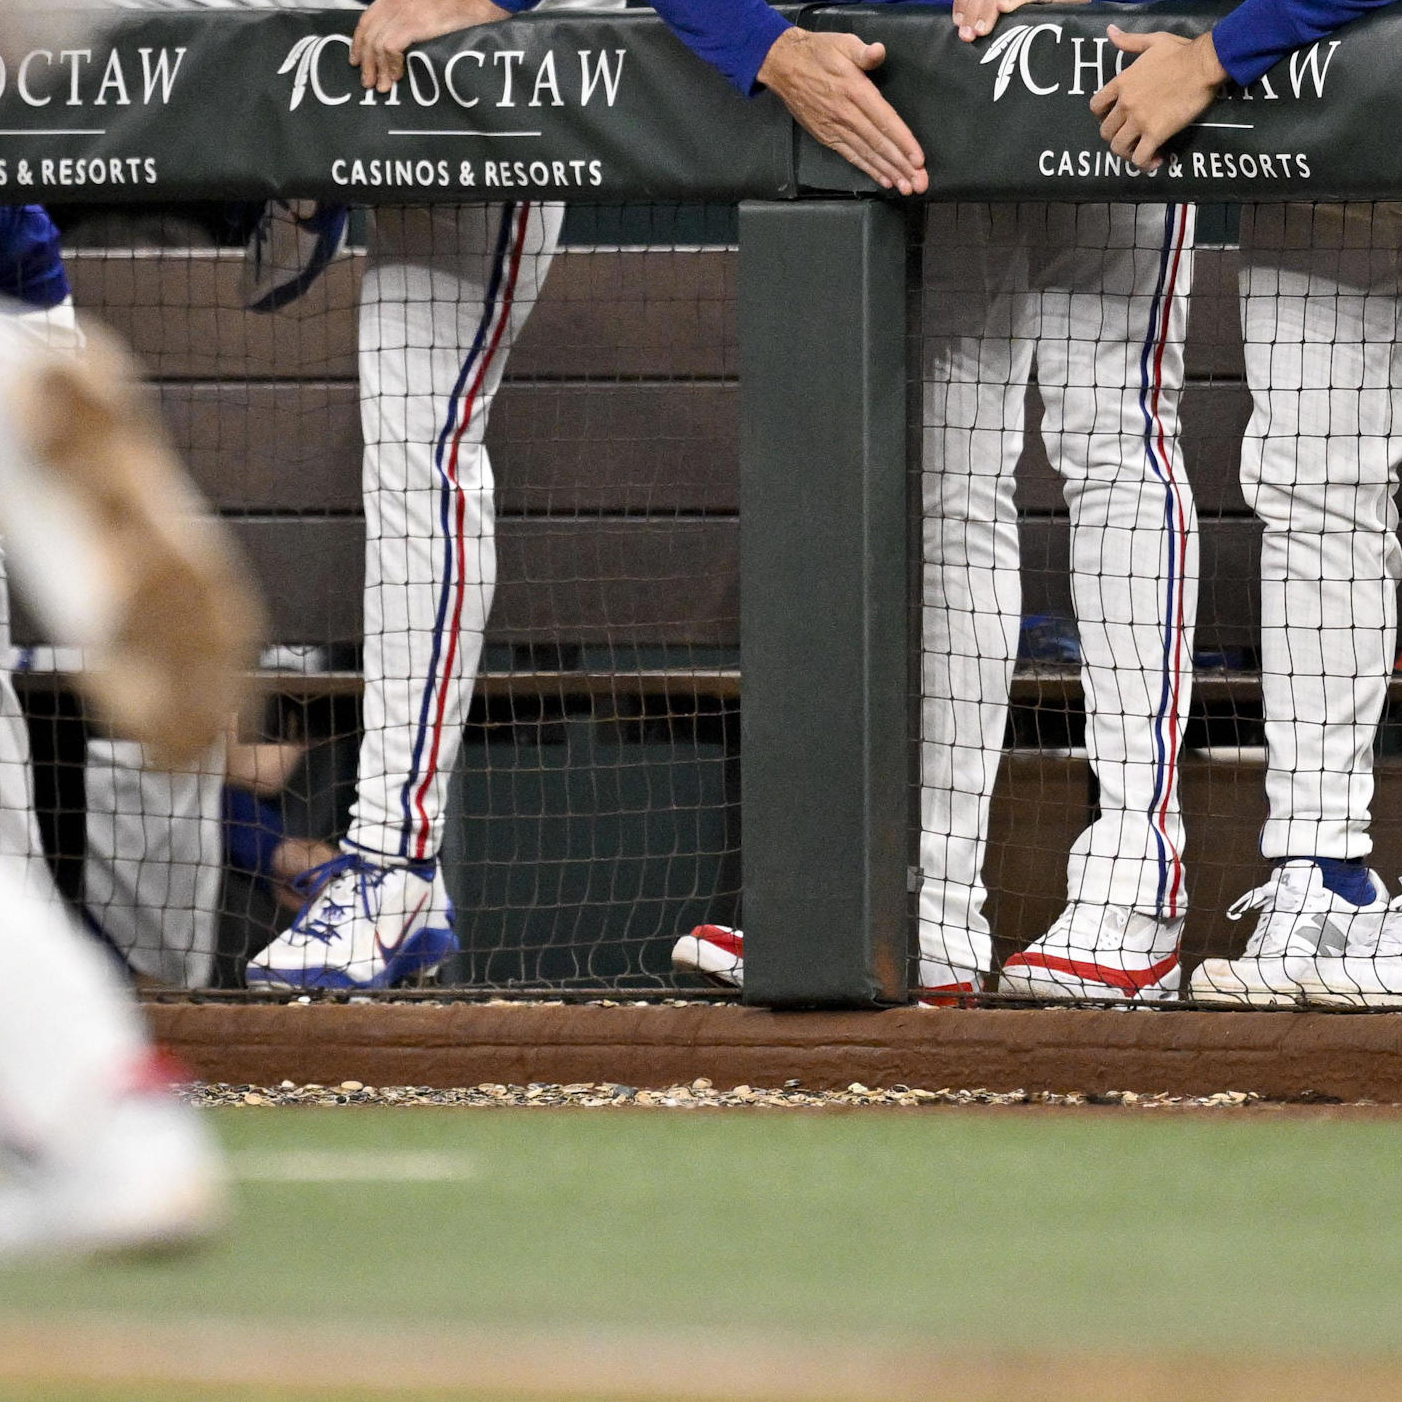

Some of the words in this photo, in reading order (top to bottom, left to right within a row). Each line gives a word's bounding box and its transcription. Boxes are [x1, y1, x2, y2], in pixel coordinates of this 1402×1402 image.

[16, 158, 34, 186] &
[41, 156, 158, 186] RESORTS
[331, 159, 450, 187] CASINOS
[459, 160, 476, 186] &
[484, 159, 603, 187] RESORTS
[1038, 149, 1158, 178] CASIN
[1167, 152, 1183, 178] &
[1192, 151, 1311, 179] RESORTS
